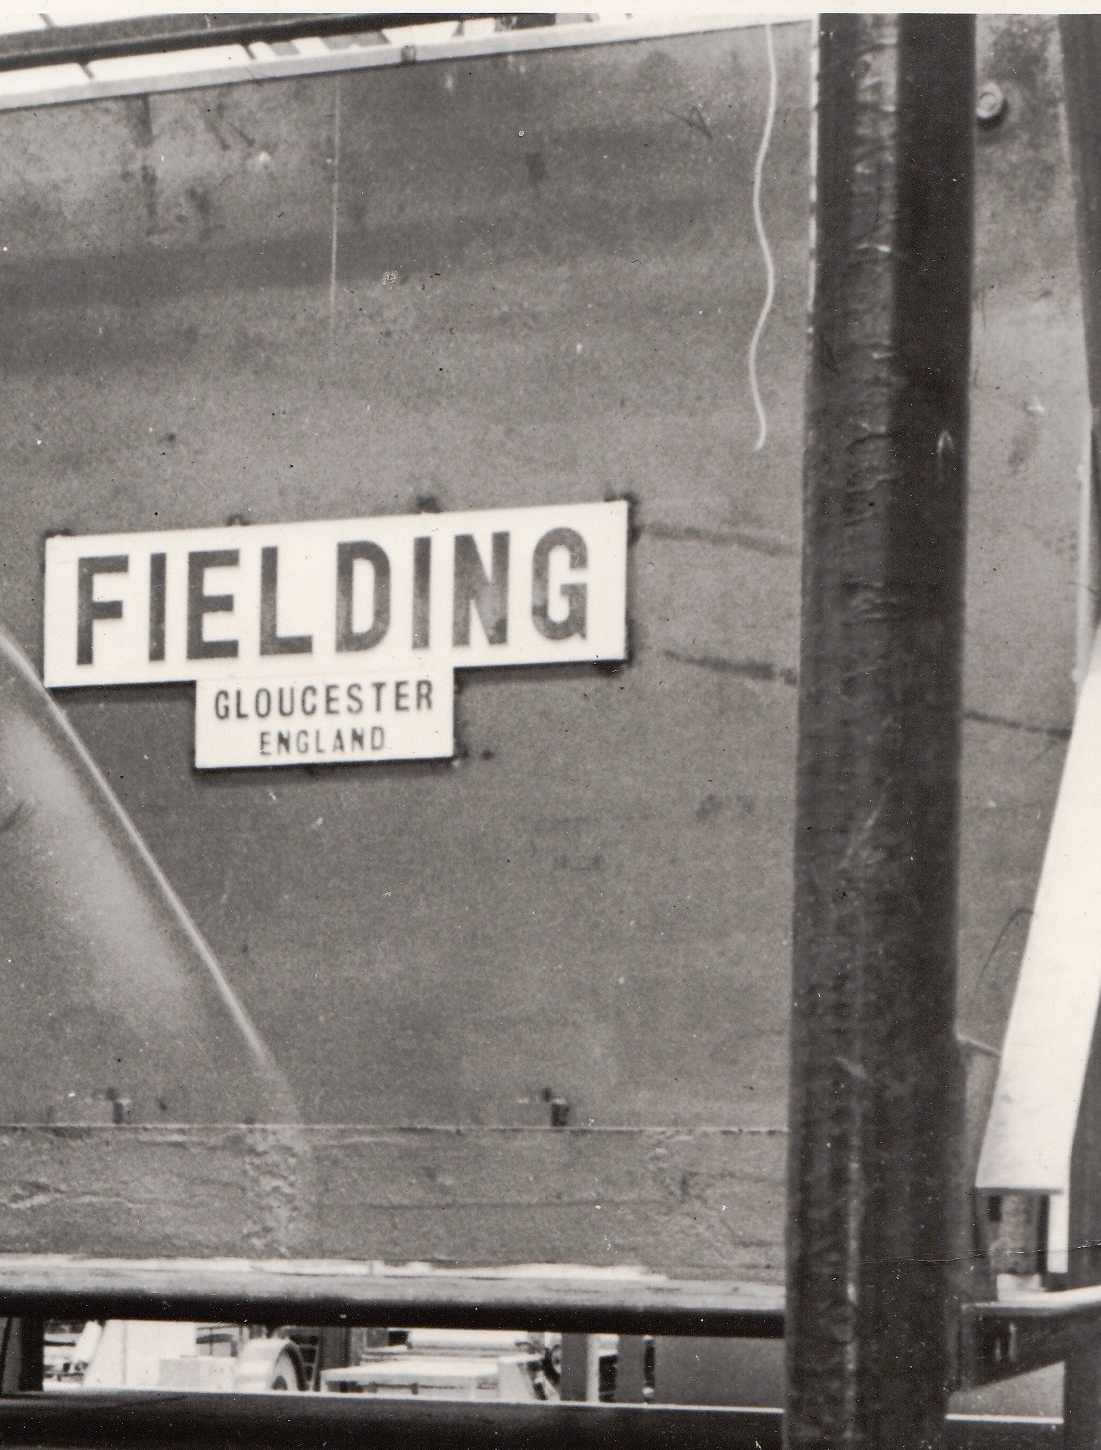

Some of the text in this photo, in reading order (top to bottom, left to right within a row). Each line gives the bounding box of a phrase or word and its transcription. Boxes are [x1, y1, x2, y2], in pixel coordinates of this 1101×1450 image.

[76, 527, 589, 666] FIELDING
[214, 680, 434, 720] GLOUCESTER
[259, 726, 386, 757] ENGLAND
